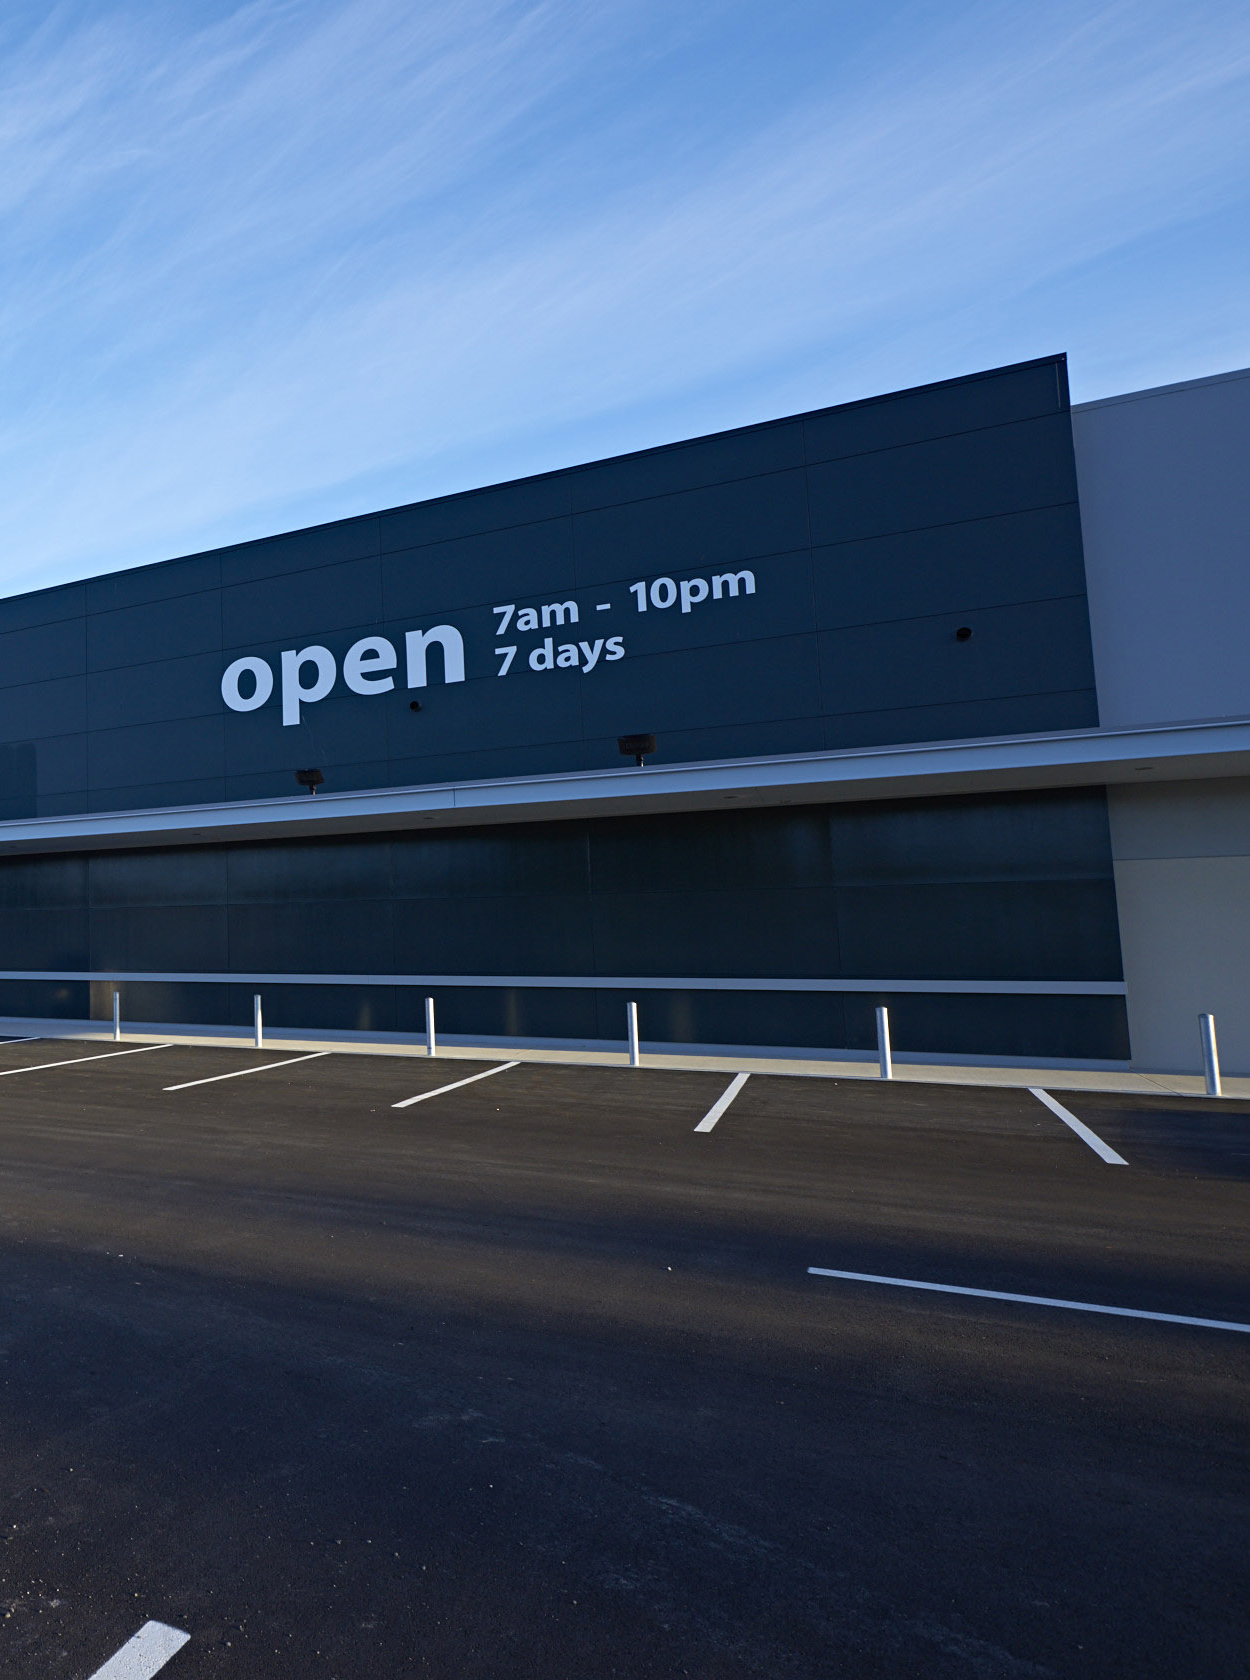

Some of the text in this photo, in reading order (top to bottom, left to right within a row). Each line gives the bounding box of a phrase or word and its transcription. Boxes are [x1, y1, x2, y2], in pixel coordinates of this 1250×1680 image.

[493, 600, 579, 636] 7am
[629, 569, 757, 614] 10pm
[221, 624, 466, 727] open
[494, 635, 625, 677] 7 days
